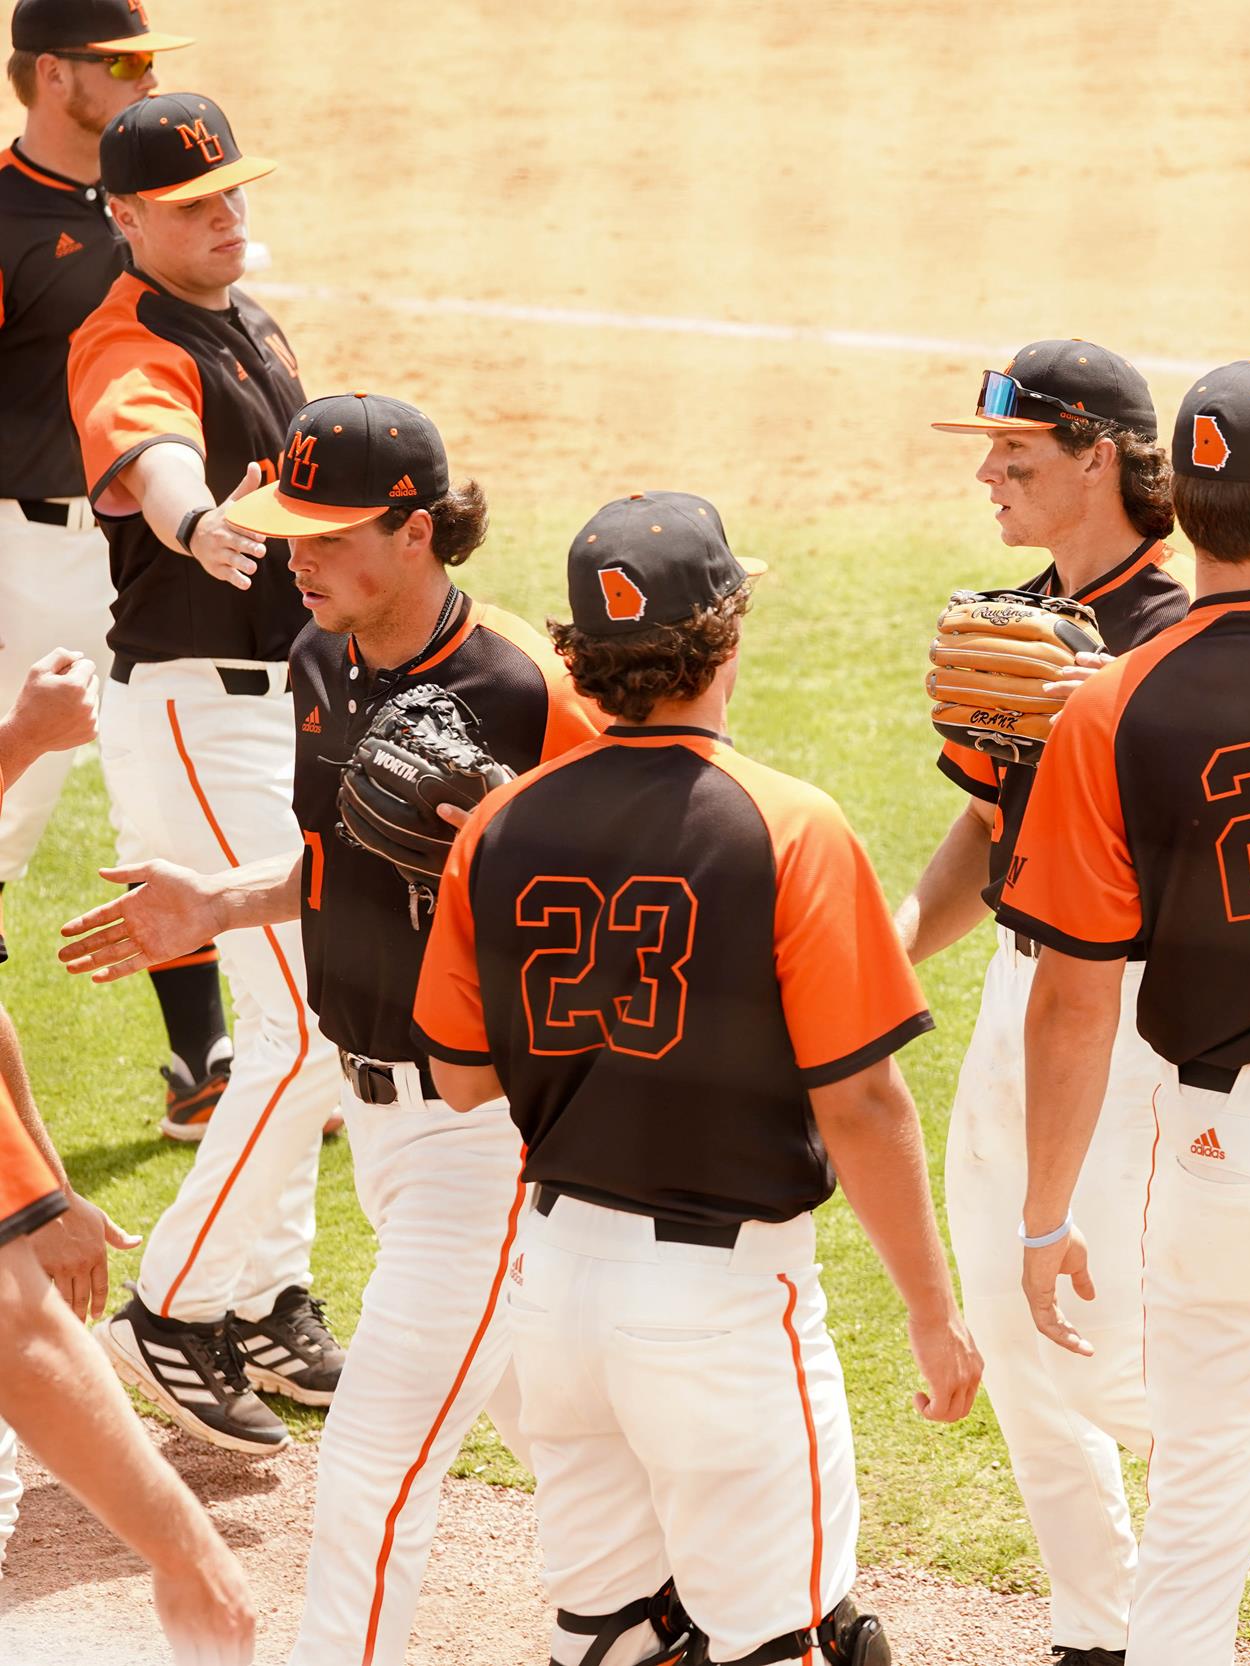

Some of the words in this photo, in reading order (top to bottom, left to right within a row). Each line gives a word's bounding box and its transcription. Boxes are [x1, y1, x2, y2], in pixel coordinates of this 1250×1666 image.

[388, 487, 417, 498] adidas
[970, 605, 1034, 623] Rawlings
[970, 709, 1019, 732] CRANK
[372, 749, 419, 784] WORTH
[515, 875, 698, 1060] 23
[1190, 1143, 1226, 1160] adidas
